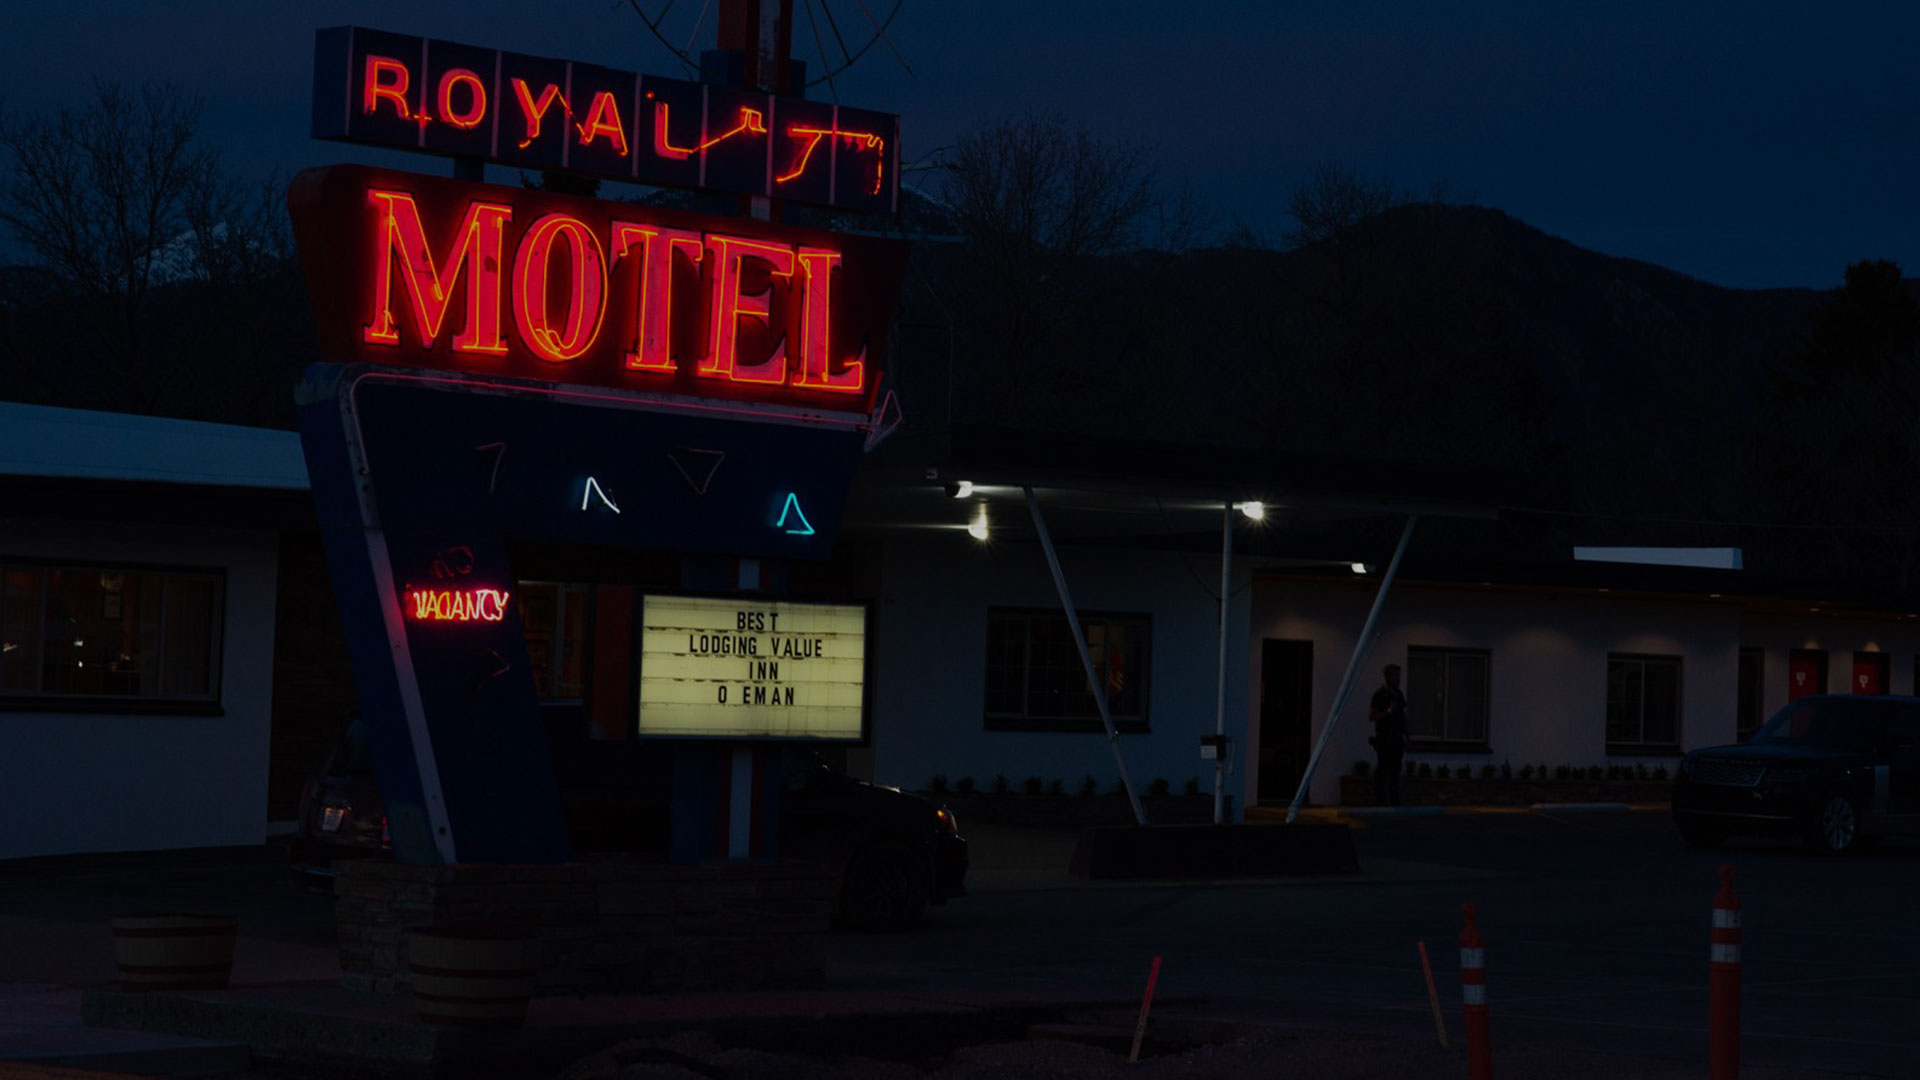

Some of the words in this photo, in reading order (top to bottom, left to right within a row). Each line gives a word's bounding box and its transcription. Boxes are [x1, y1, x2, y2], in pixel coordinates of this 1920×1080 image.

[363, 53, 692, 161] ROYAL
[363, 188, 868, 394] MOTEL
[412, 588, 510, 621] VACANCY
[737, 612, 778, 632] BEST
[689, 634, 757, 656] LODGING
[771, 637, 823, 658] VALUE
[749, 661, 778, 681] INN
